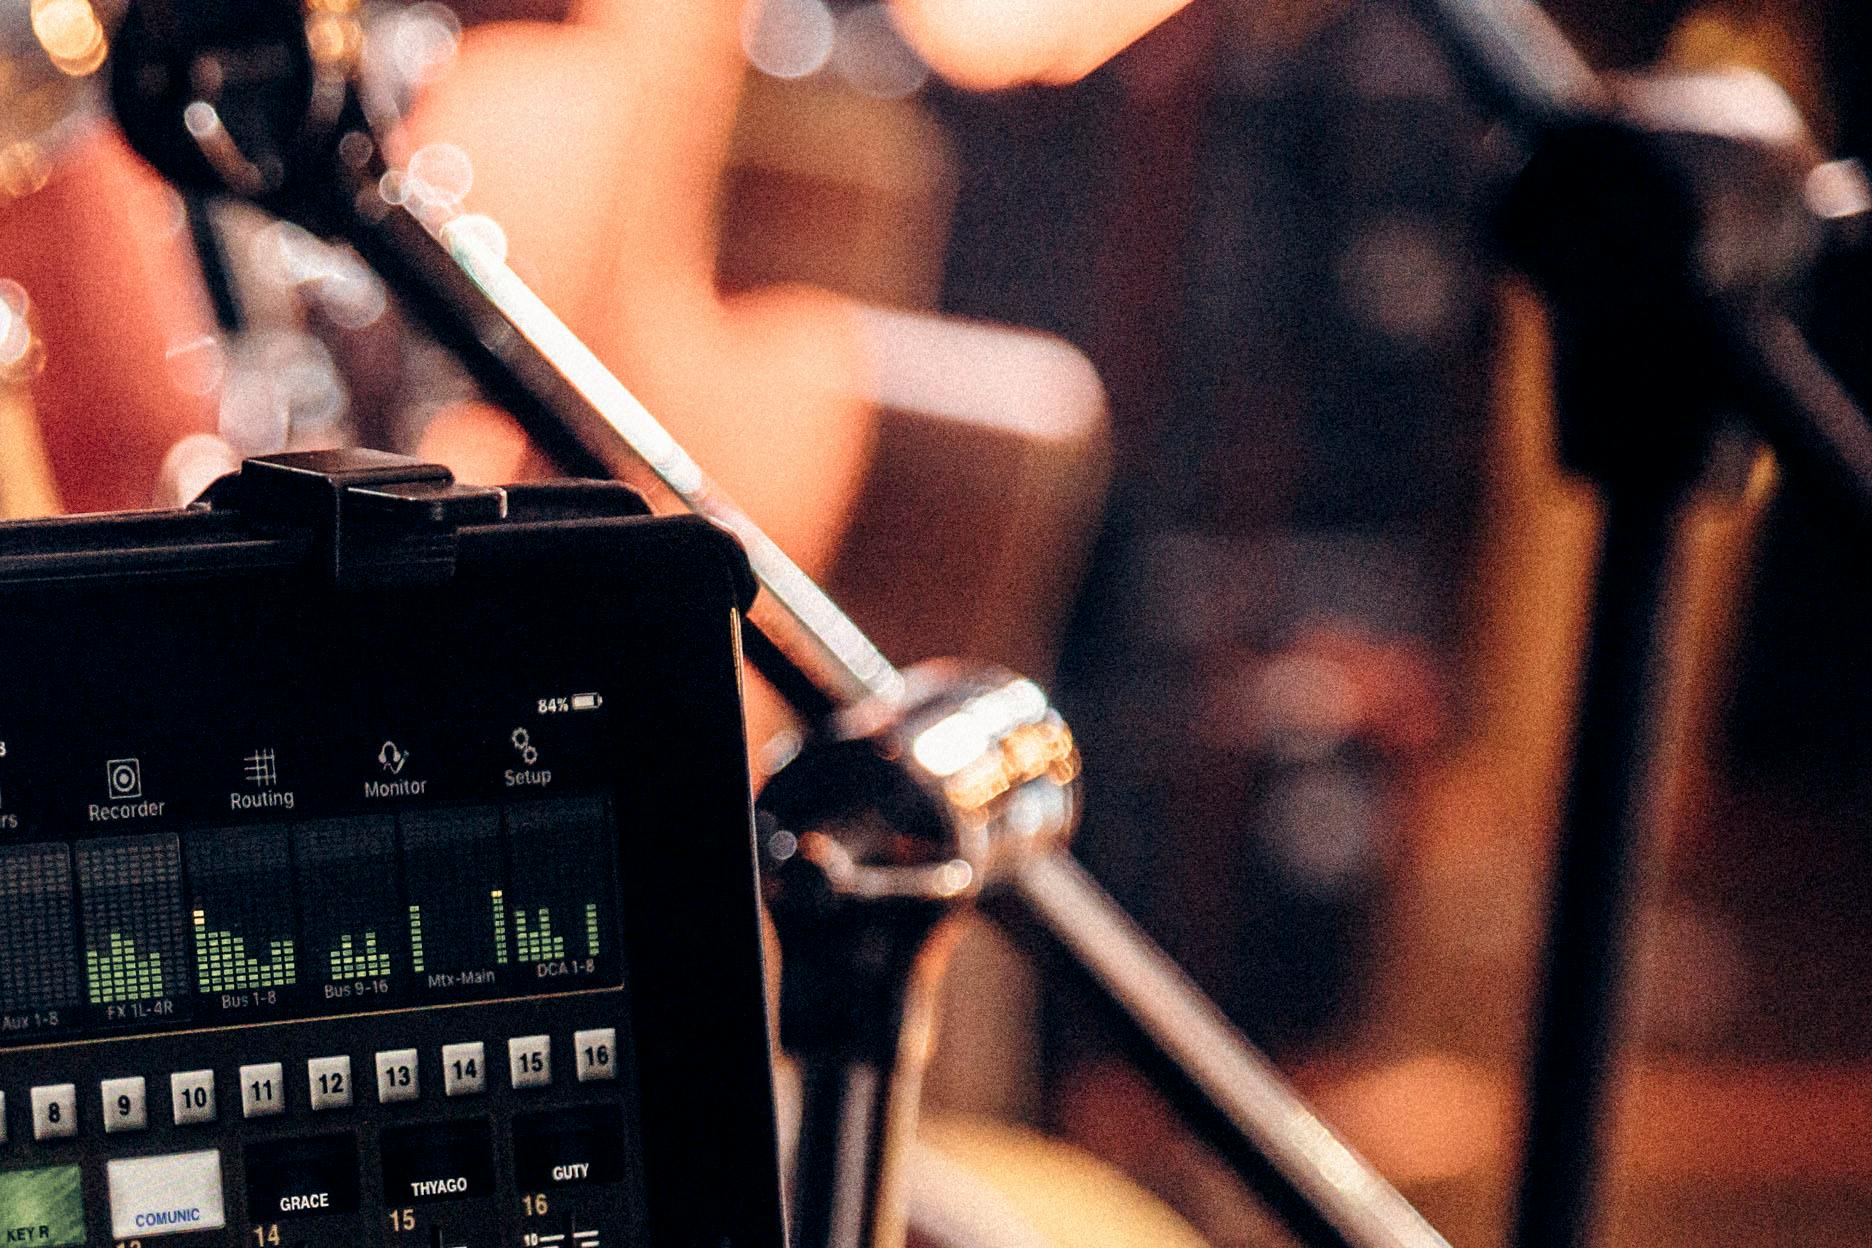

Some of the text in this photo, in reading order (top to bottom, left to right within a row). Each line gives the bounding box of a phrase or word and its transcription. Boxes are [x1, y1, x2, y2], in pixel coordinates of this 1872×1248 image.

[538, 697, 568, 713] 84%
[505, 769, 551, 787] Setup
[365, 779, 427, 798] Monitor
[231, 787, 294, 811] Routing
[89, 800, 165, 821] Recorder
[537, 959, 595, 978] DCA 1-8
[429, 969, 496, 989] Mtx-Main
[324, 980, 388, 999] Bus 9-16
[222, 991, 277, 1009] Bus 1-8
[108, 1001, 174, 1020] FX 1L-4R
[2, 1012, 59, 1030] Aux 1-8
[519, 1052, 543, 1073] 15
[584, 1044, 609, 1066] 16
[385, 1065, 410, 1087] 13
[453, 1058, 476, 1080] 14
[251, 1079, 273, 1101] 11
[318, 1072, 343, 1094] 12
[118, 1095, 131, 1116] 9
[181, 1087, 207, 1109] 10
[48, 1102, 61, 1123] 8
[552, 1163, 589, 1181] GUTY
[411, 1177, 467, 1197] THYAGO
[280, 1192, 329, 1211] GRACE
[524, 1194, 548, 1216] 16
[135, 1208, 200, 1228] COMUNIC
[390, 1209, 416, 1232] 15
[7, 1224, 49, 1243] KEY R
[254, 1223, 281, 1248] 14
[524, 1233, 538, 1247] 10
